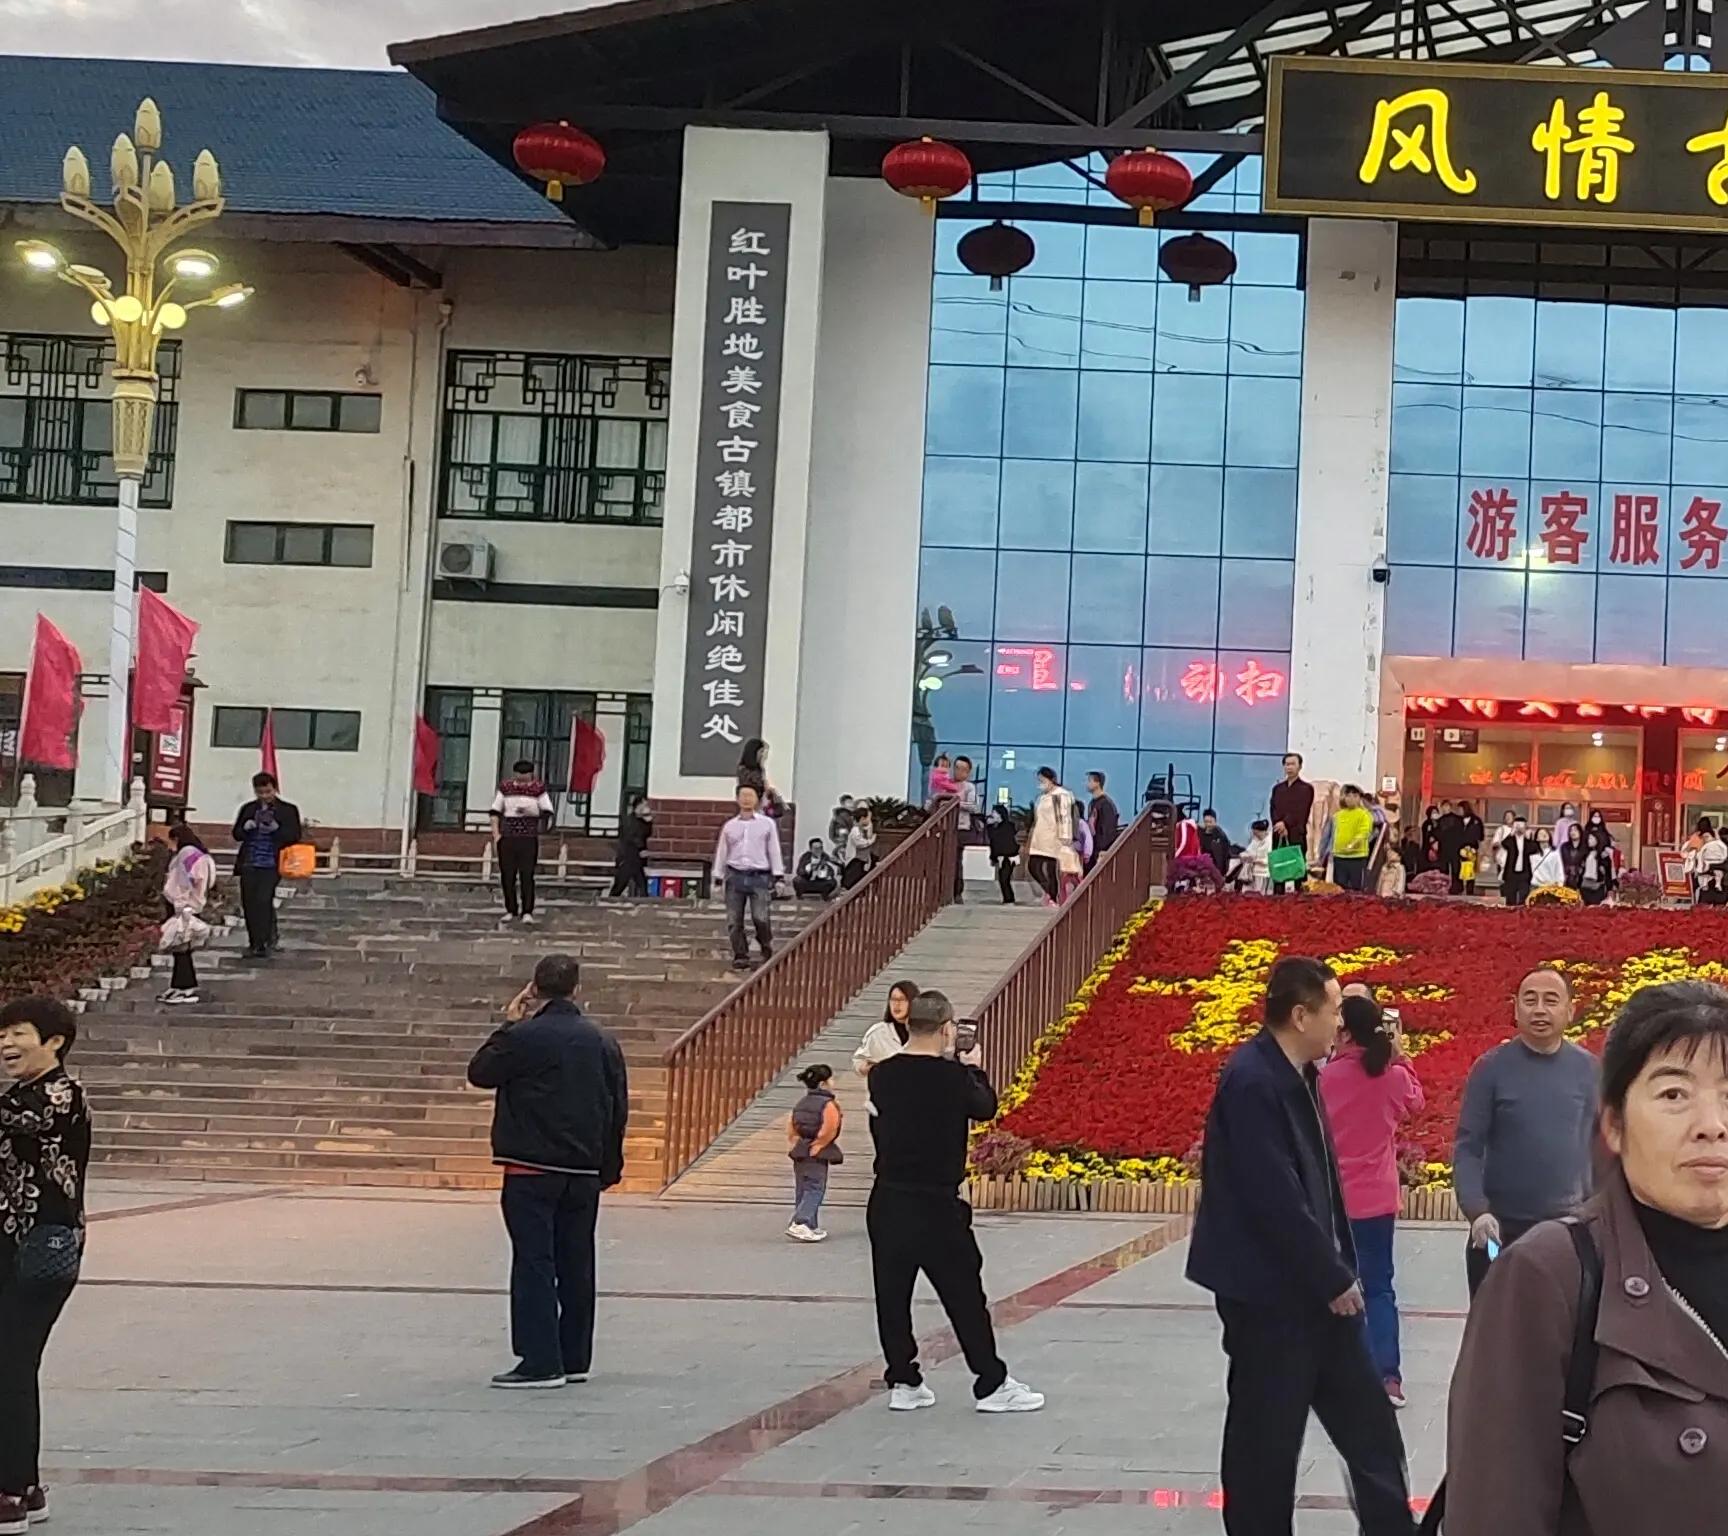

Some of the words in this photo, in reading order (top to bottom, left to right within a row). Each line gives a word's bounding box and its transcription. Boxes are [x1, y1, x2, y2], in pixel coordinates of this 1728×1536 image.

[700, 227, 771, 744] 红叶胜地美食古镇都市休闲绝佳处
